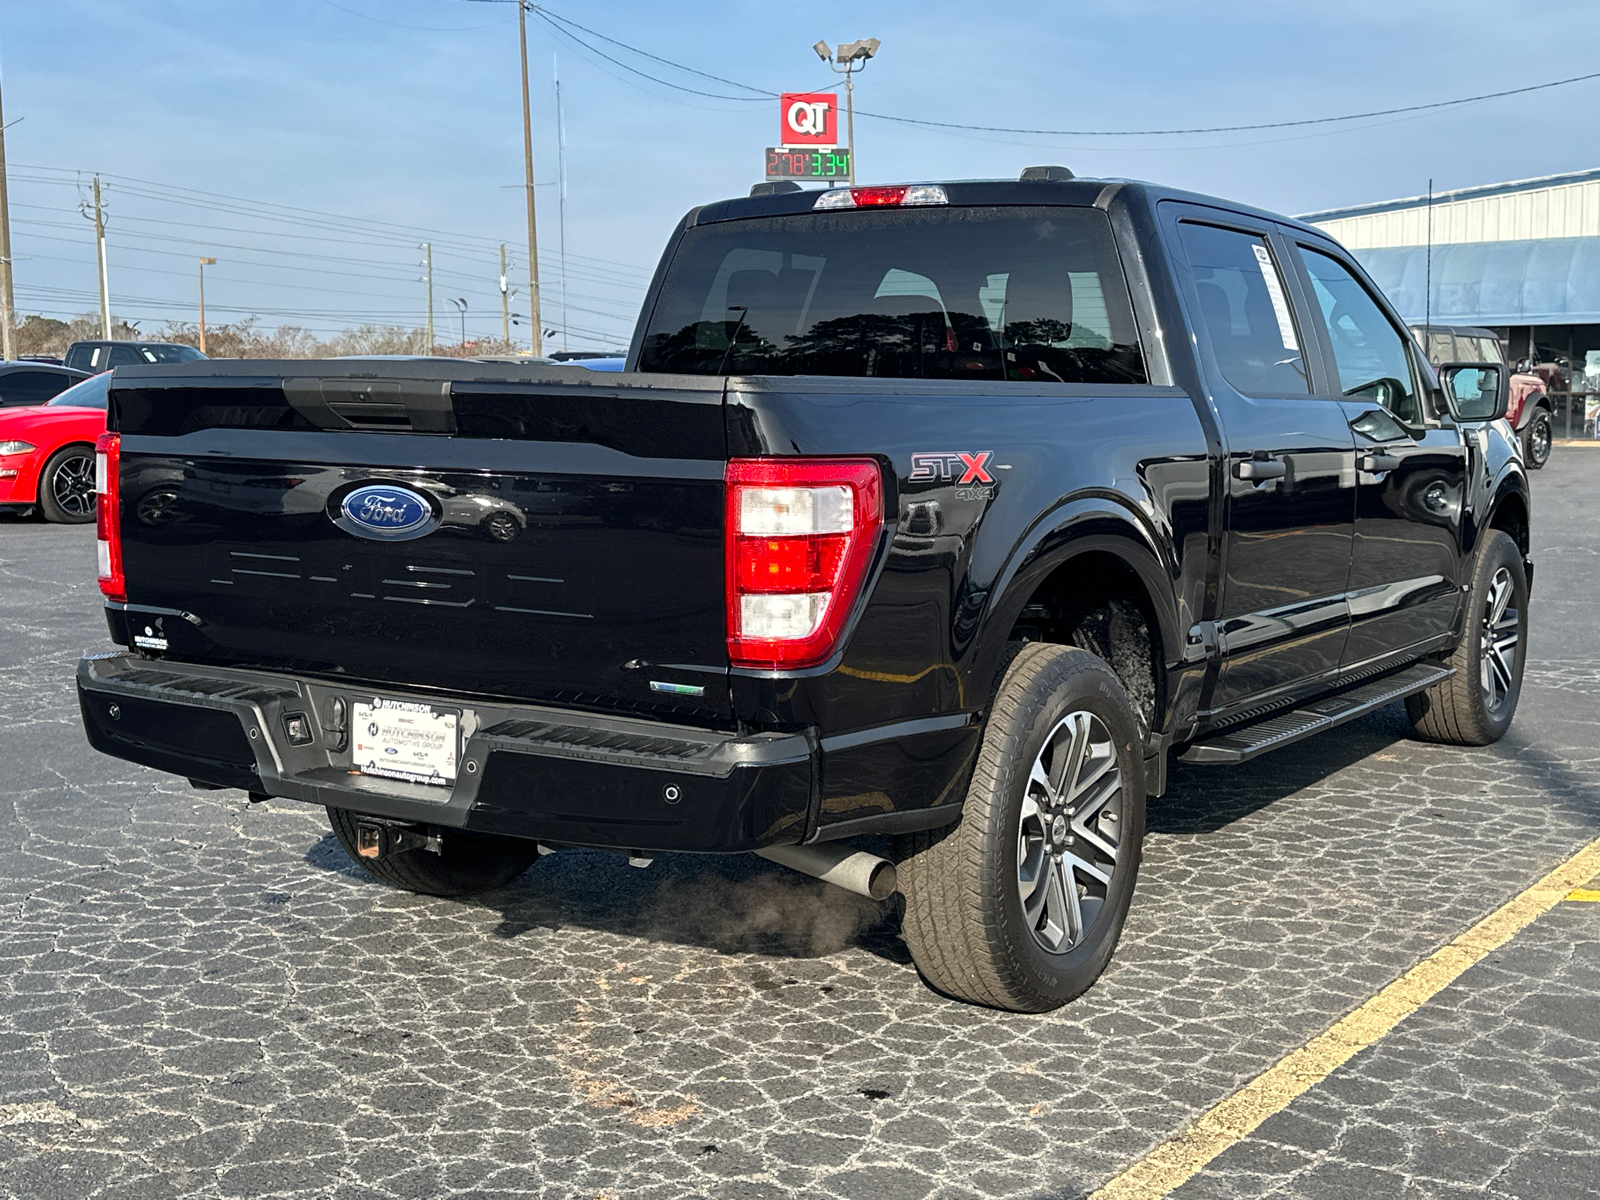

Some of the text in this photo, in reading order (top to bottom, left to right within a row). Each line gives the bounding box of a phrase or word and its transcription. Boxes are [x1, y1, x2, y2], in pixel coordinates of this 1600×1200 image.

[788, 101, 829, 135] QT
[908, 451, 997, 488] STX
[360, 494, 408, 523] Ford
[382, 699, 432, 714] HUTCHINSON
[382, 726, 447, 743] HUTCHINSON
[382, 737, 444, 751] AUTOMOTIVE GROUP
